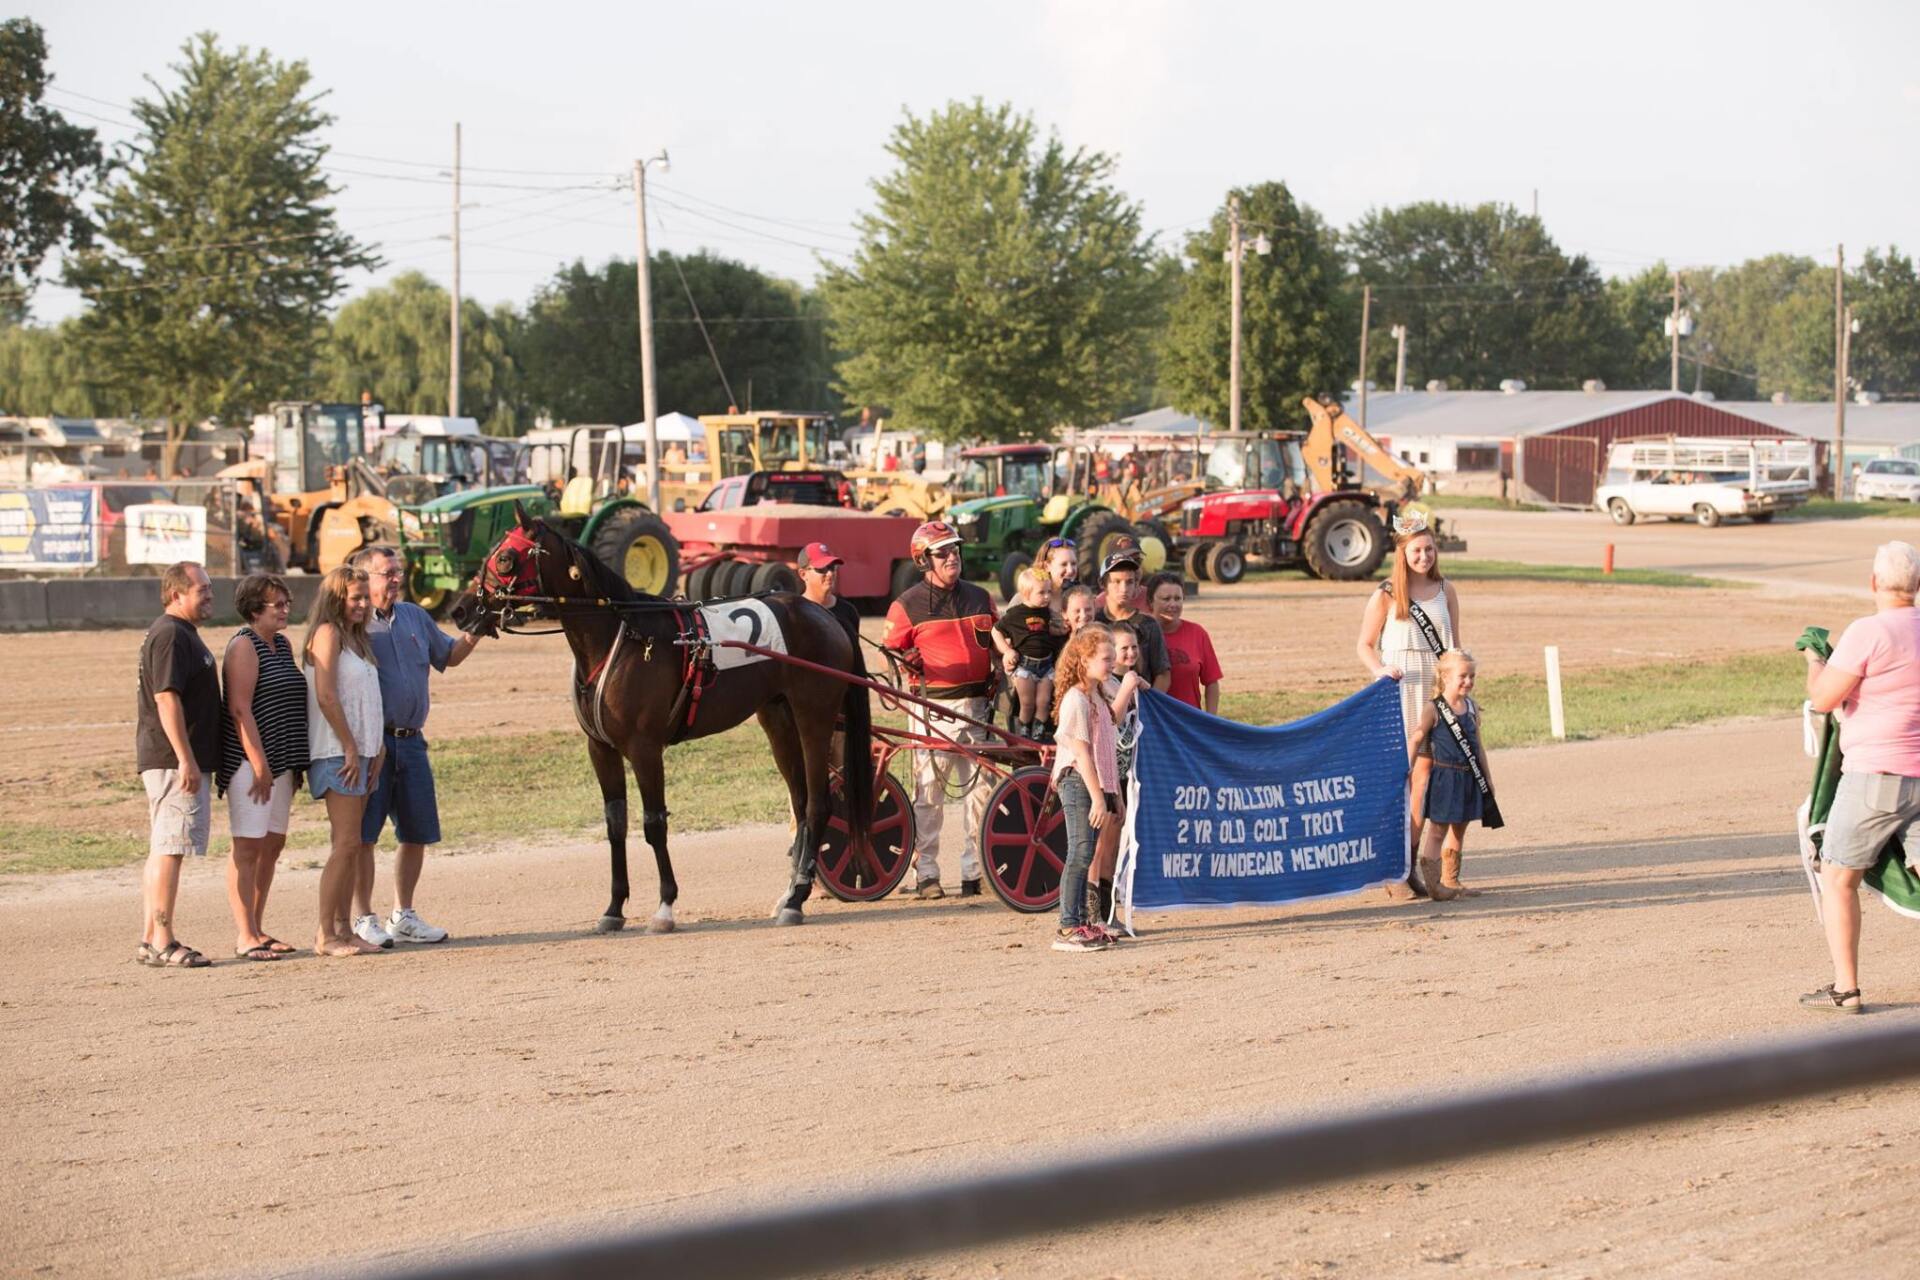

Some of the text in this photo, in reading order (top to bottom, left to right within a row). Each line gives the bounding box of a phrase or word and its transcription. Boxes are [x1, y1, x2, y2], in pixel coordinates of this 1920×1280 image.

[728, 607, 772, 658] 2
[1410, 604, 1442, 653] Coles County
[1450, 722, 1463, 741] Miss
[1174, 775, 1356, 812] 2017 STALLION STAKES
[1177, 809, 1345, 844] 2 YR OLD COLT TROT
[1162, 836, 1376, 878] WREX VANDECAR MEMORIAL
